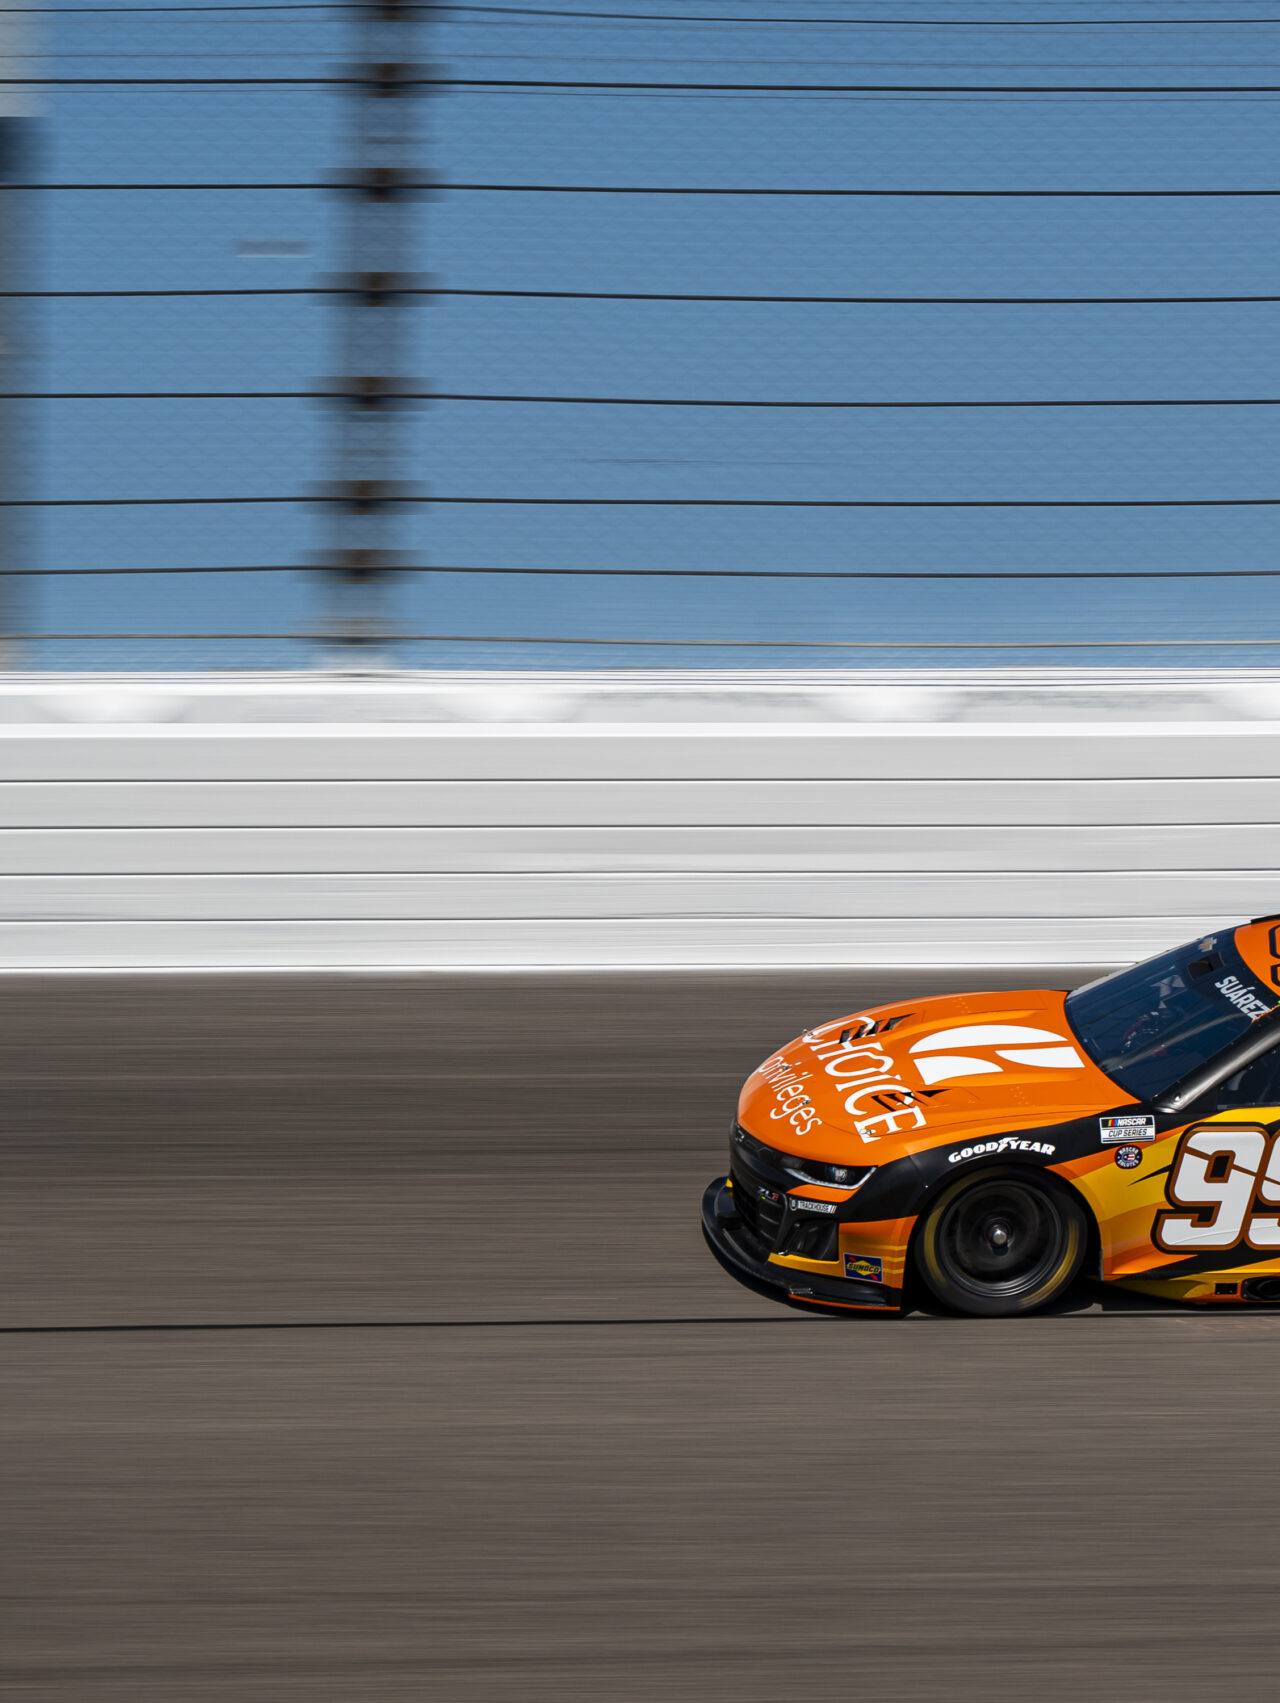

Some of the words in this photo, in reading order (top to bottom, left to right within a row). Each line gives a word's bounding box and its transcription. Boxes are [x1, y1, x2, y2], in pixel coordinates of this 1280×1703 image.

[1214, 976, 1273, 1021] SUÁREZ
[802, 1016, 927, 1143] CHOICE
[1117, 1117, 1147, 1127] NASCAR
[1108, 1130, 1123, 1138] CUP
[1123, 1128, 1148, 1137] SERIES
[948, 1137, 1056, 1164] GOODYEAR
[847, 1261, 881, 1274] SUNOCO
